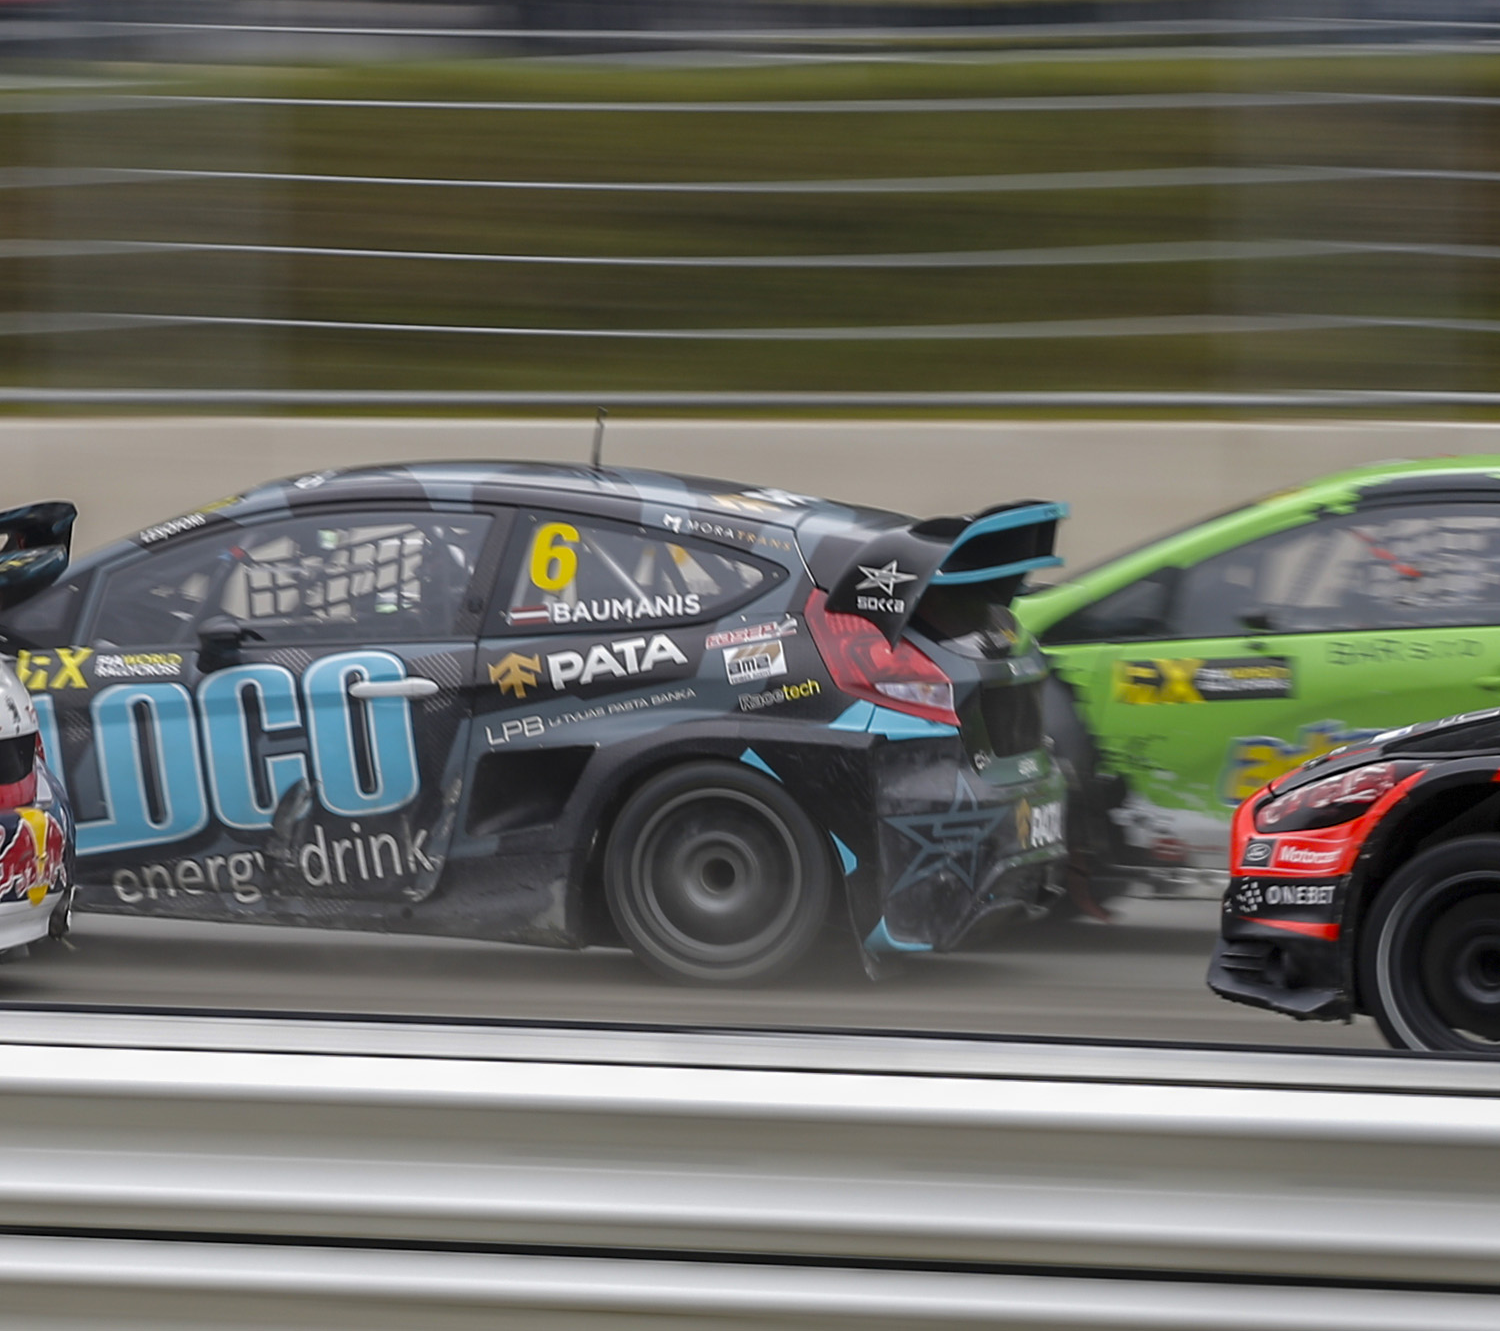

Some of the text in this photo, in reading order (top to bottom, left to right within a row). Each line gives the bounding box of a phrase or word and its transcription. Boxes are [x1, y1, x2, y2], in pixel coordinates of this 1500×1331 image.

[529, 521, 580, 592] 6
[551, 593, 701, 625] BAUMANIS
[546, 634, 689, 692] PATA
[484, 714, 546, 746] LPB
[651, 687, 697, 705] BANKA
[738, 678, 821, 712] Racetech
[301, 821, 434, 888] drink
[1265, 884, 1336, 905] ONEBET
